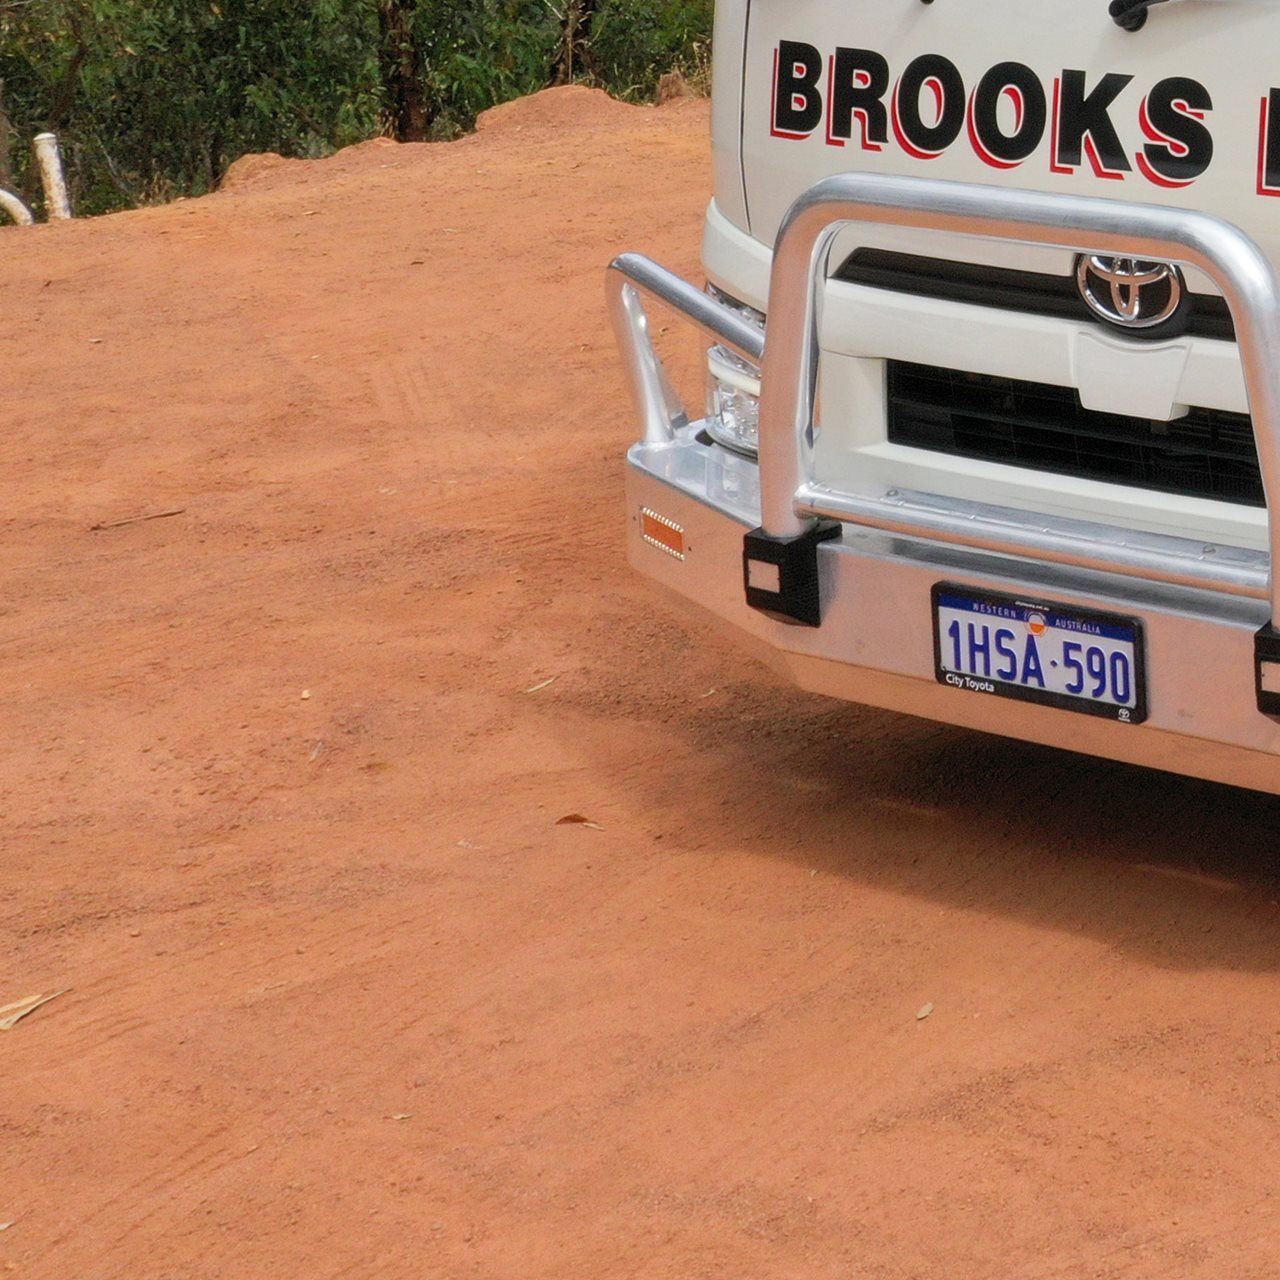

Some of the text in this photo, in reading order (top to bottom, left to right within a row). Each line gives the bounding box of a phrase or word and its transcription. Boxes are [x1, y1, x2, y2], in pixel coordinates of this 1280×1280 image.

[770, 39, 1214, 190] BROOKS
[972, 602, 1017, 619] WESTERN
[1054, 618, 1102, 635] AUSTRALIA
[945, 673, 995, 693] City Toyota
